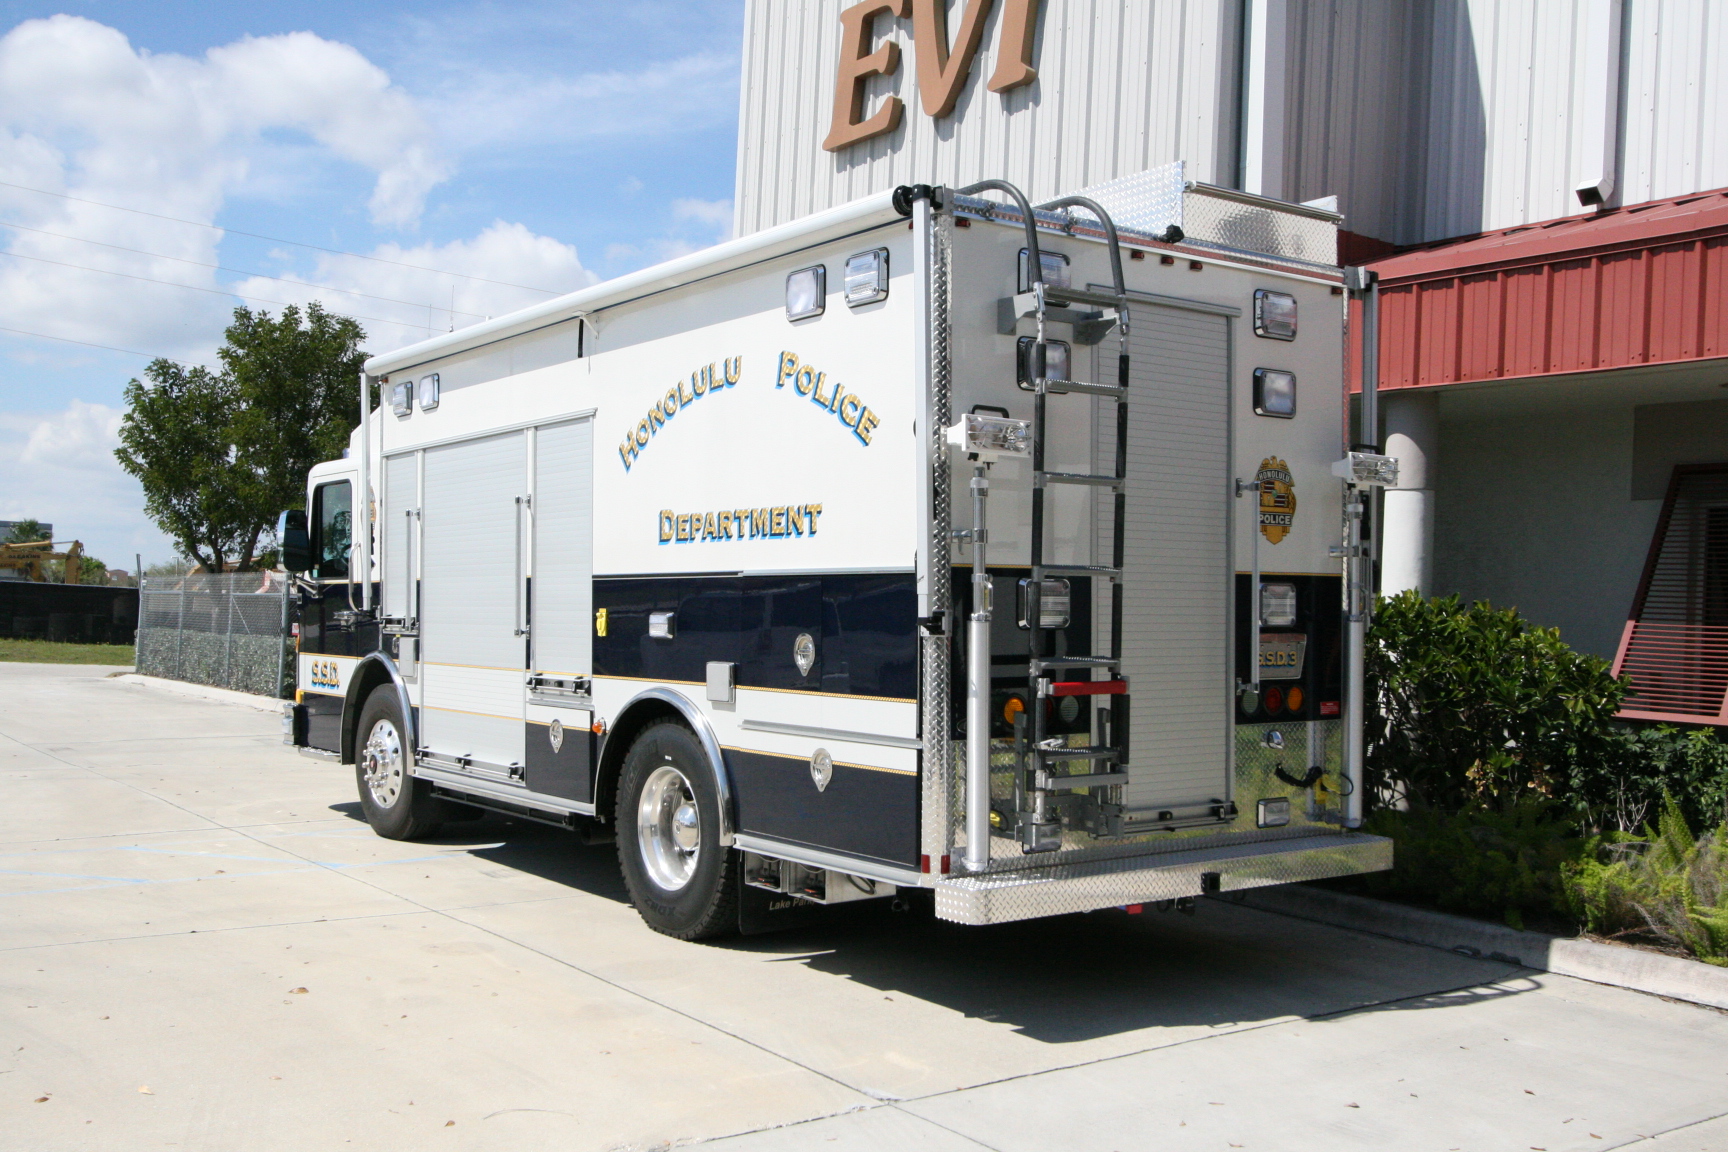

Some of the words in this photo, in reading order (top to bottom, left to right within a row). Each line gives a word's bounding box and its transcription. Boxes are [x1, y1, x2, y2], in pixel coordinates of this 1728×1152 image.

[822, 0, 1036, 152] EVI
[618, 355, 743, 474] HONOLULU
[775, 350, 881, 448] POLICE
[1258, 470, 1290, 482] HONOLULU
[658, 502, 823, 546] DEPARTMENT
[1259, 514, 1291, 525] POLICE
[769, 900, 791, 911] Lake
